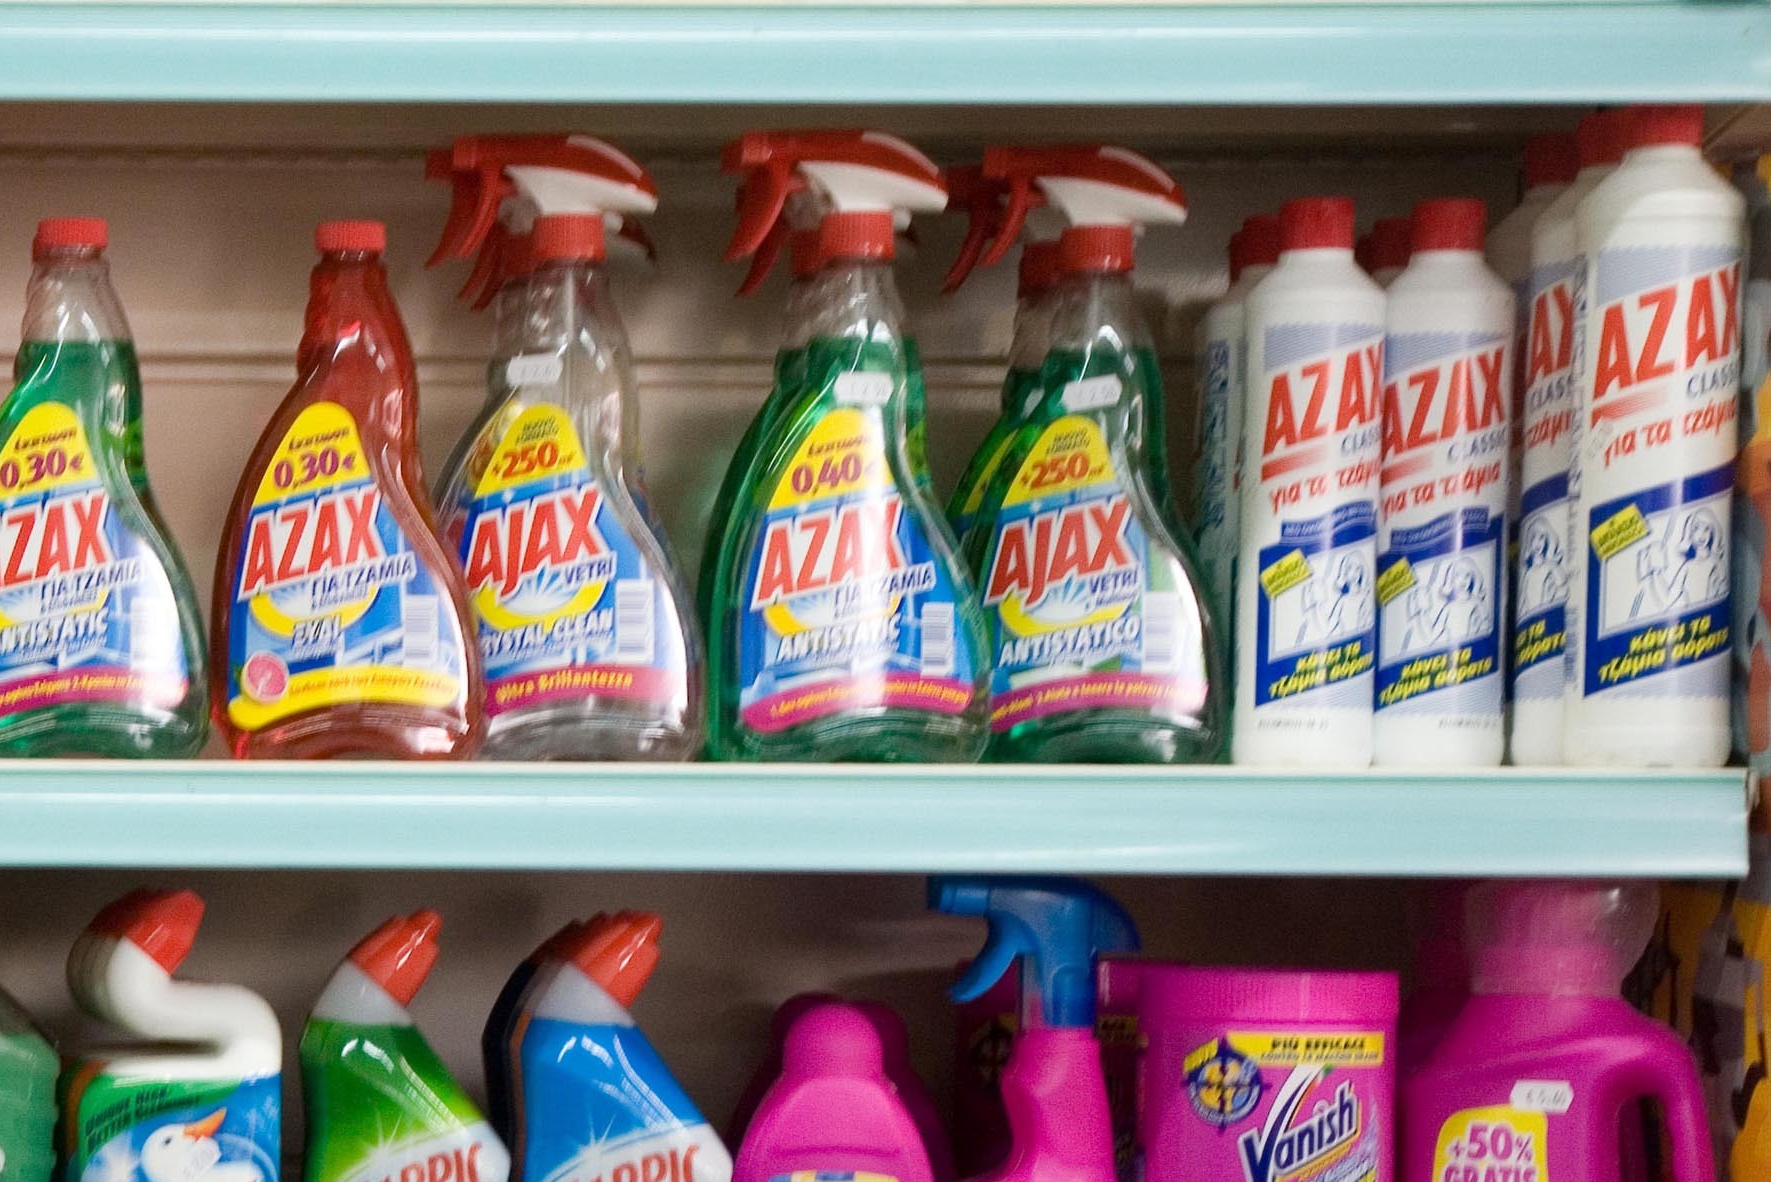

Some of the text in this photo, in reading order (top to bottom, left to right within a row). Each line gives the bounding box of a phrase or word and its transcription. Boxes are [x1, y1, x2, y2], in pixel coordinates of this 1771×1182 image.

[1592, 263, 1743, 401] AZAX
[1262, 342, 1383, 457] AZAX
[1381, 346, 1505, 459] AZAX
[1604, 416, 1673, 469] για τα
[242, 490, 380, 594] AZAX
[467, 486, 602, 598] AJAX
[989, 498, 1135, 606] AJAX
[40, 563, 142, 601] ΓΙΑ ΤΖΑΜΙΑ
[311, 557, 413, 598] ΓΙΑ ΤΖΑΜΙΑ
[562, 558, 614, 587] VETRI
[1088, 570, 1139, 595] VETRI
[480, 608, 615, 658] RYSTAL CLEAN
[997, 614, 1142, 668] ANTISTATICO
[1450, 1122, 1534, 1163] +50%
